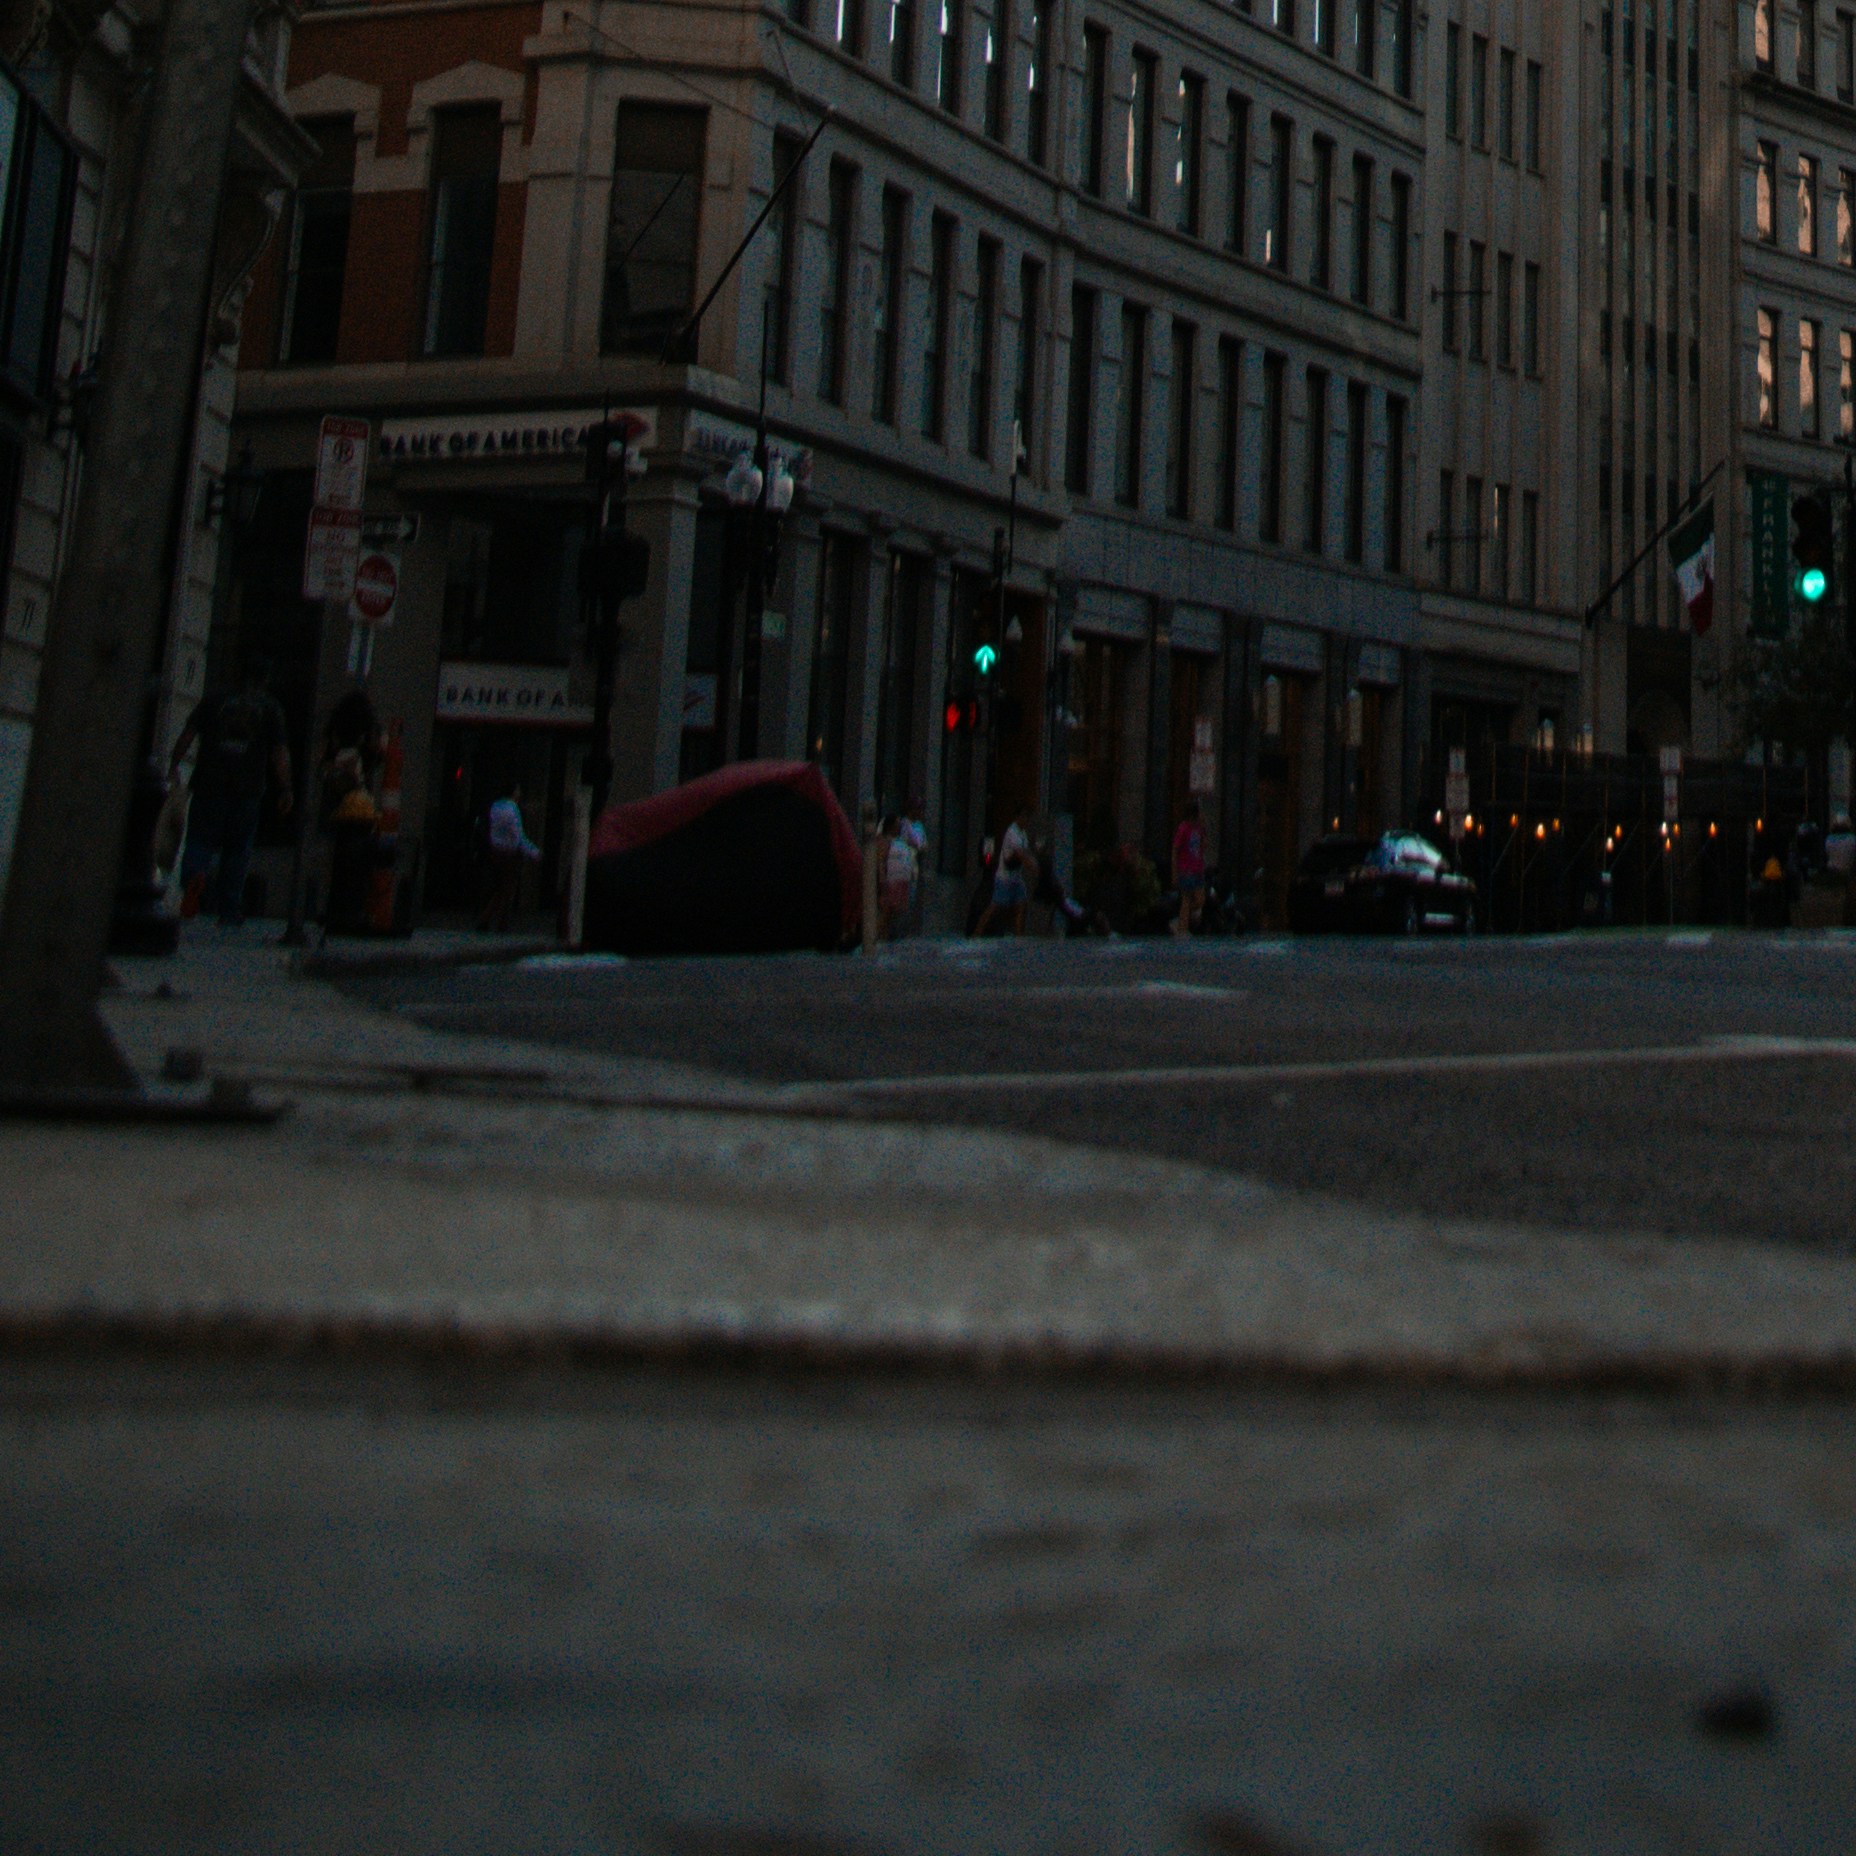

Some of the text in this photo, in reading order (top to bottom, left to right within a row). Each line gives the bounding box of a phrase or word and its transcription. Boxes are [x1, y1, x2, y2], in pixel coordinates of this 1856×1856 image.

[380, 433, 443, 456] BANK
[449, 431, 478, 452] OF
[446, 685, 509, 705] BANK
[516, 688, 545, 706] OF
